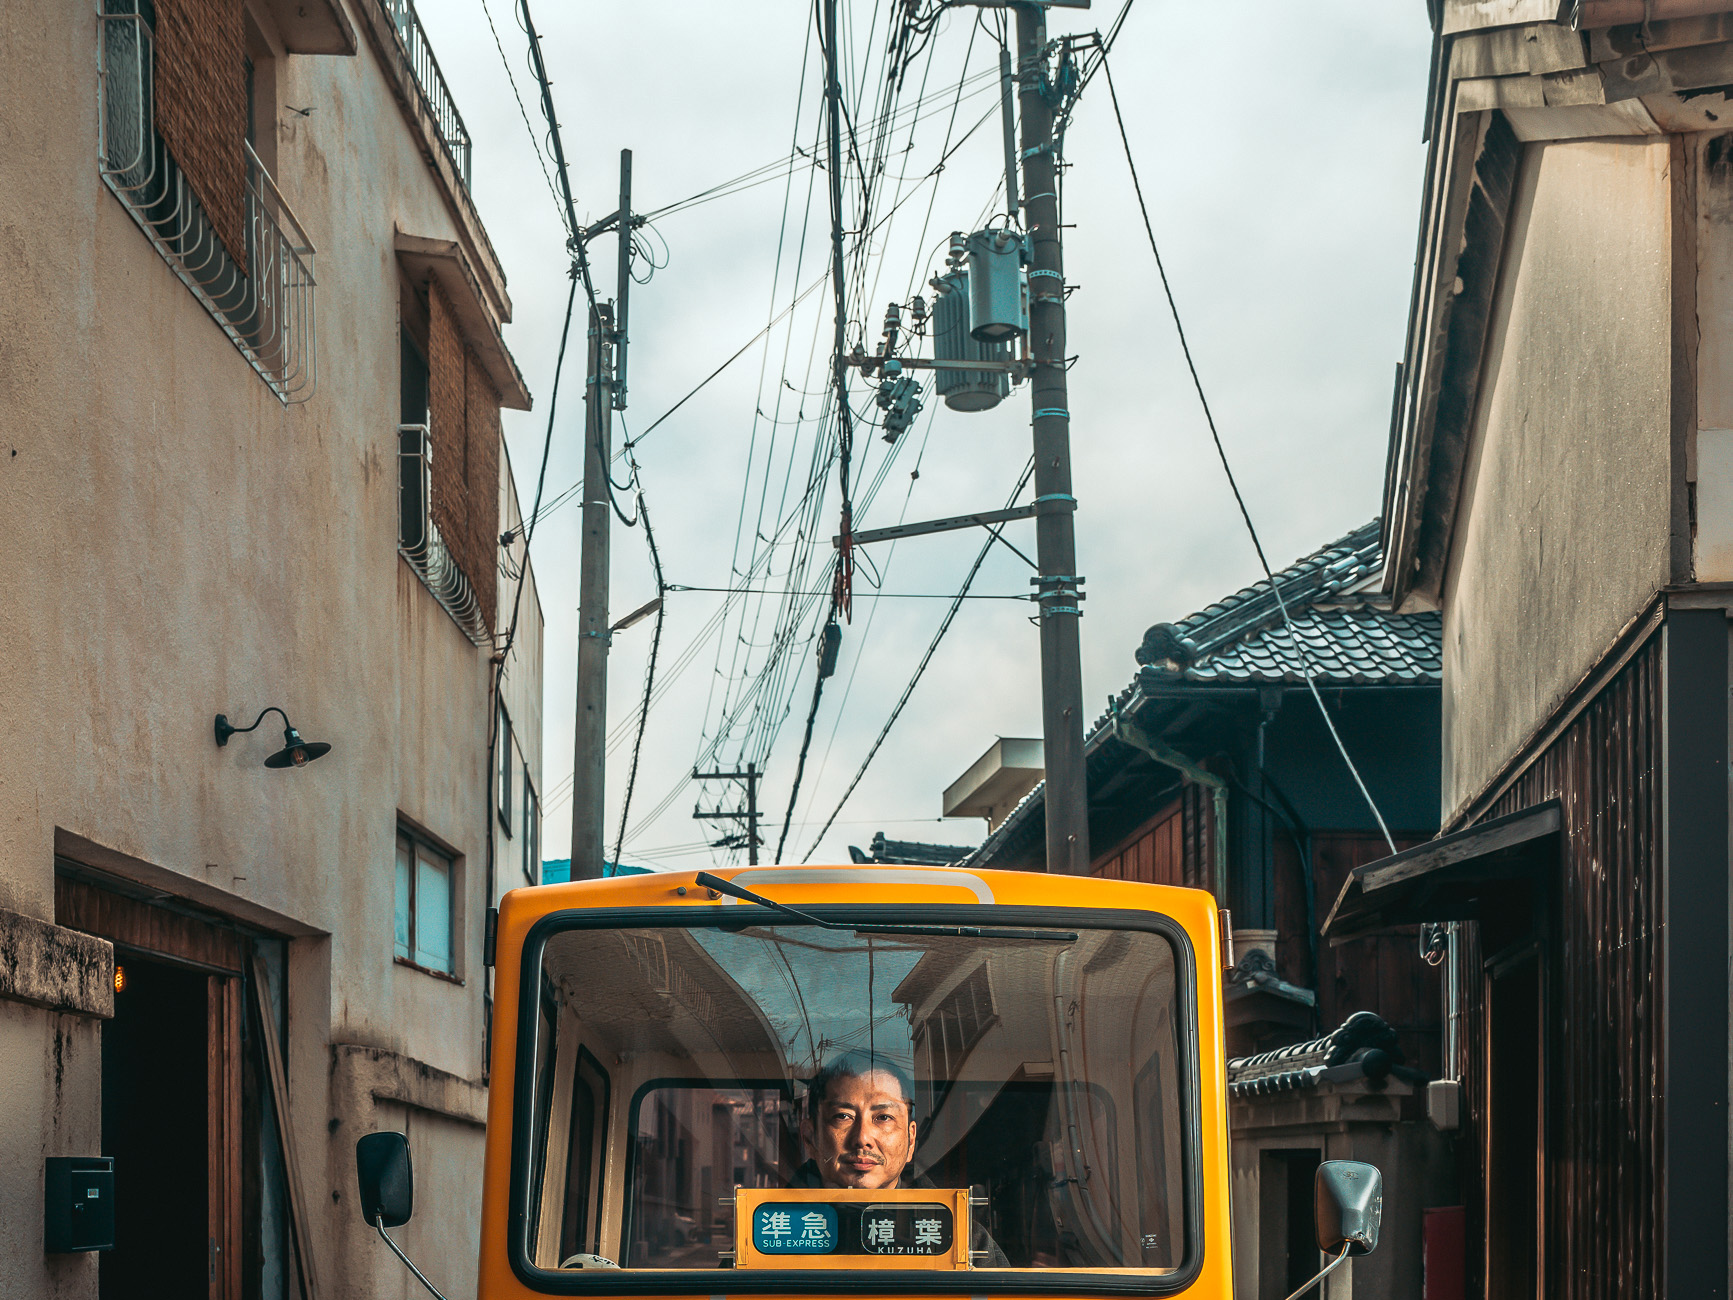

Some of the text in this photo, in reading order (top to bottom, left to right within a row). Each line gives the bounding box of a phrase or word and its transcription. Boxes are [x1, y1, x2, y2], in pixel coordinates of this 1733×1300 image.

[761, 1212, 831, 1238] 準急
[867, 1219, 942, 1245] 樟葉
[763, 1239, 830, 1248] SUB-EXPRESS
[877, 1246, 932, 1254] KUZUHA
